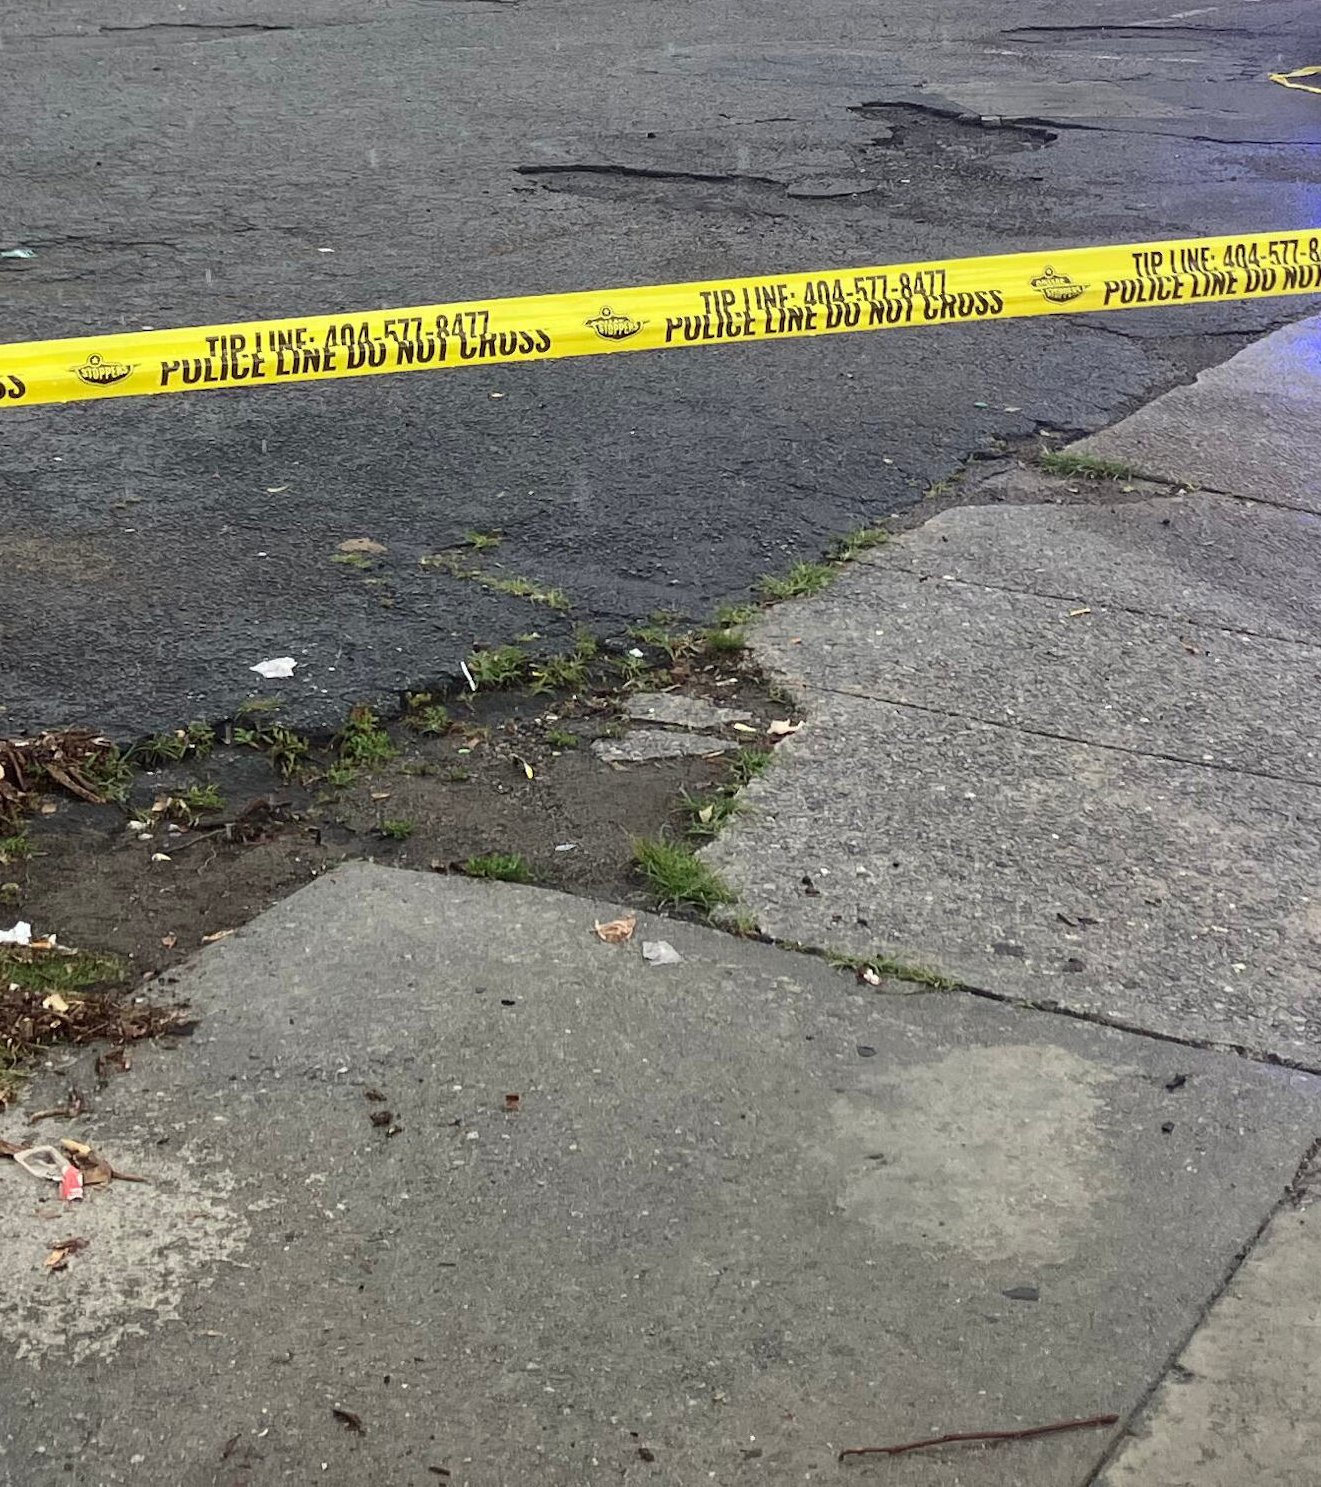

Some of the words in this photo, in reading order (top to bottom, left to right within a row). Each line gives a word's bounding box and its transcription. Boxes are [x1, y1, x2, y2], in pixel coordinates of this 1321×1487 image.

[1132, 251, 1163, 277] TIP
[1170, 246, 1216, 274] LINE:
[700, 289, 736, 316] TIP
[1103, 275, 1184, 306] POLICE
[1189, 269, 1239, 299] LINE
[1244, 266, 1277, 294] DO
[665, 311, 756, 343] POLICE
[764, 305, 818, 335] LINE
[825, 301, 861, 330] DO
[868, 296, 915, 326] NOT
[923, 289, 1005, 320] CROSS
[160, 354, 266, 387] POLICE
[276, 348, 337, 376] LINE
[347, 340, 386, 370] DO
[397, 335, 447, 366] NOT
[458, 329, 552, 360] CROSS
